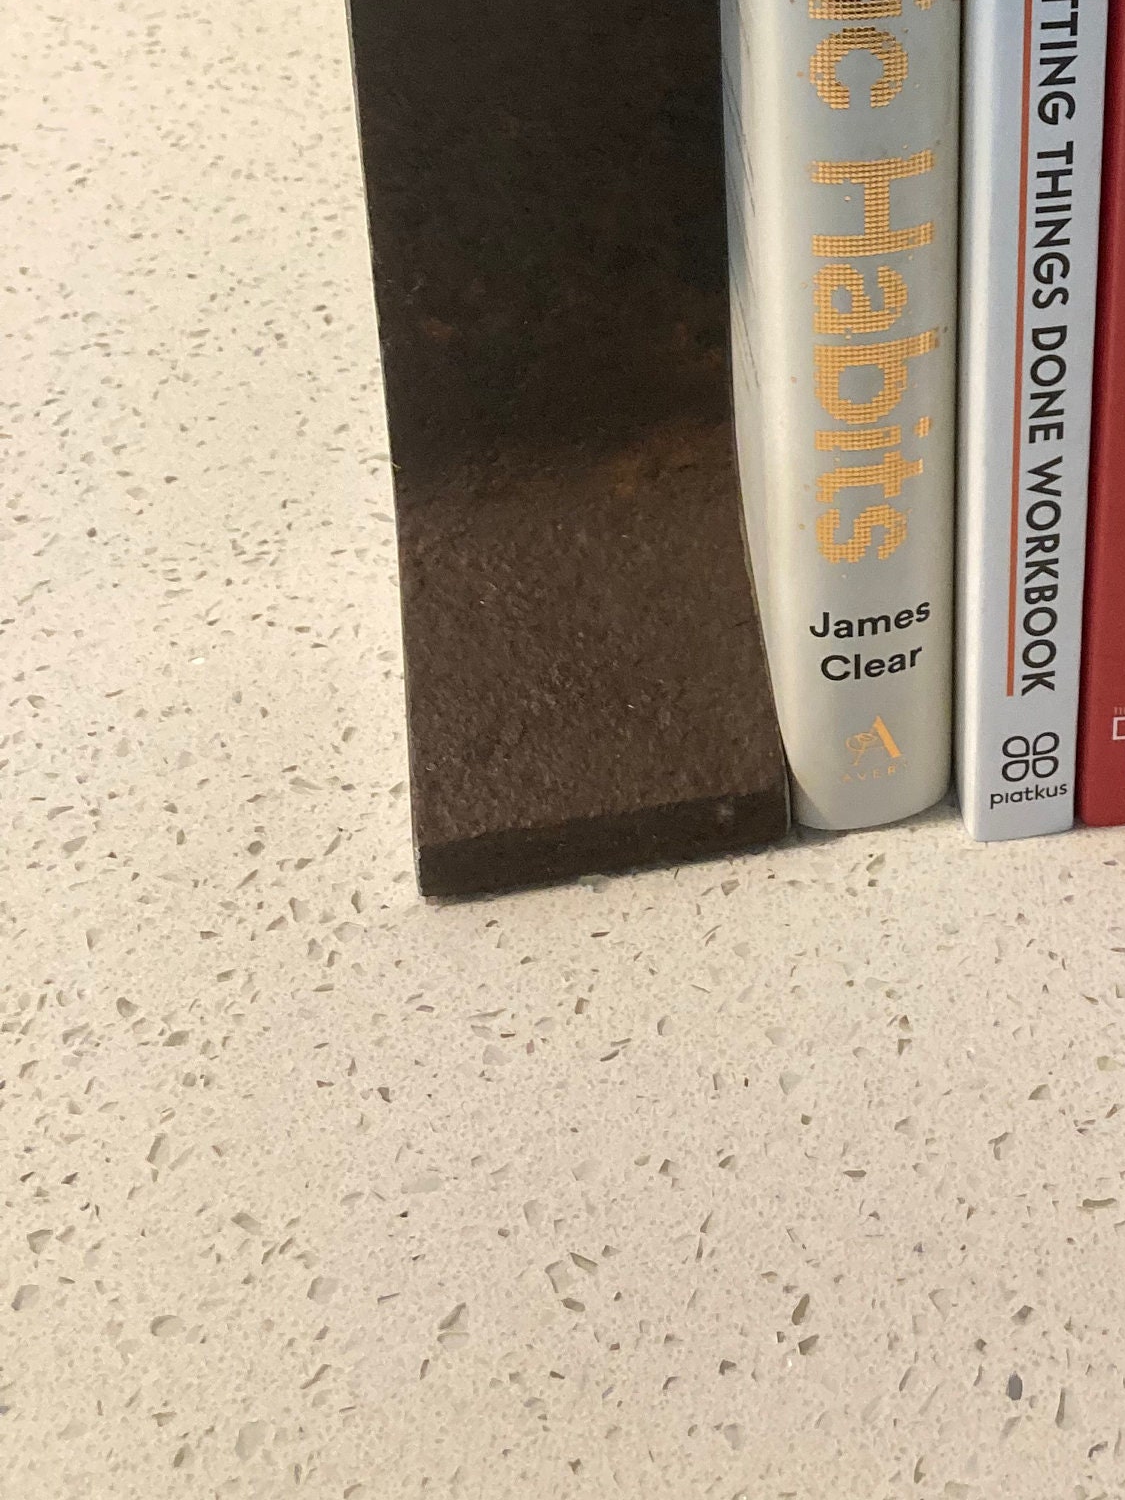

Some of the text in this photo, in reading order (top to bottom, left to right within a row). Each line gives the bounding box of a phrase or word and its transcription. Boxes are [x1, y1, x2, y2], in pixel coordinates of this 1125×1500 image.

[1031, 140, 1074, 310] THINGS
[811, 148, 939, 564] Habits
[1027, 326, 1069, 444] DONE
[809, 601, 931, 639] James
[1020, 454, 1063, 697] WORKBOOK
[820, 646, 923, 682] Clear
